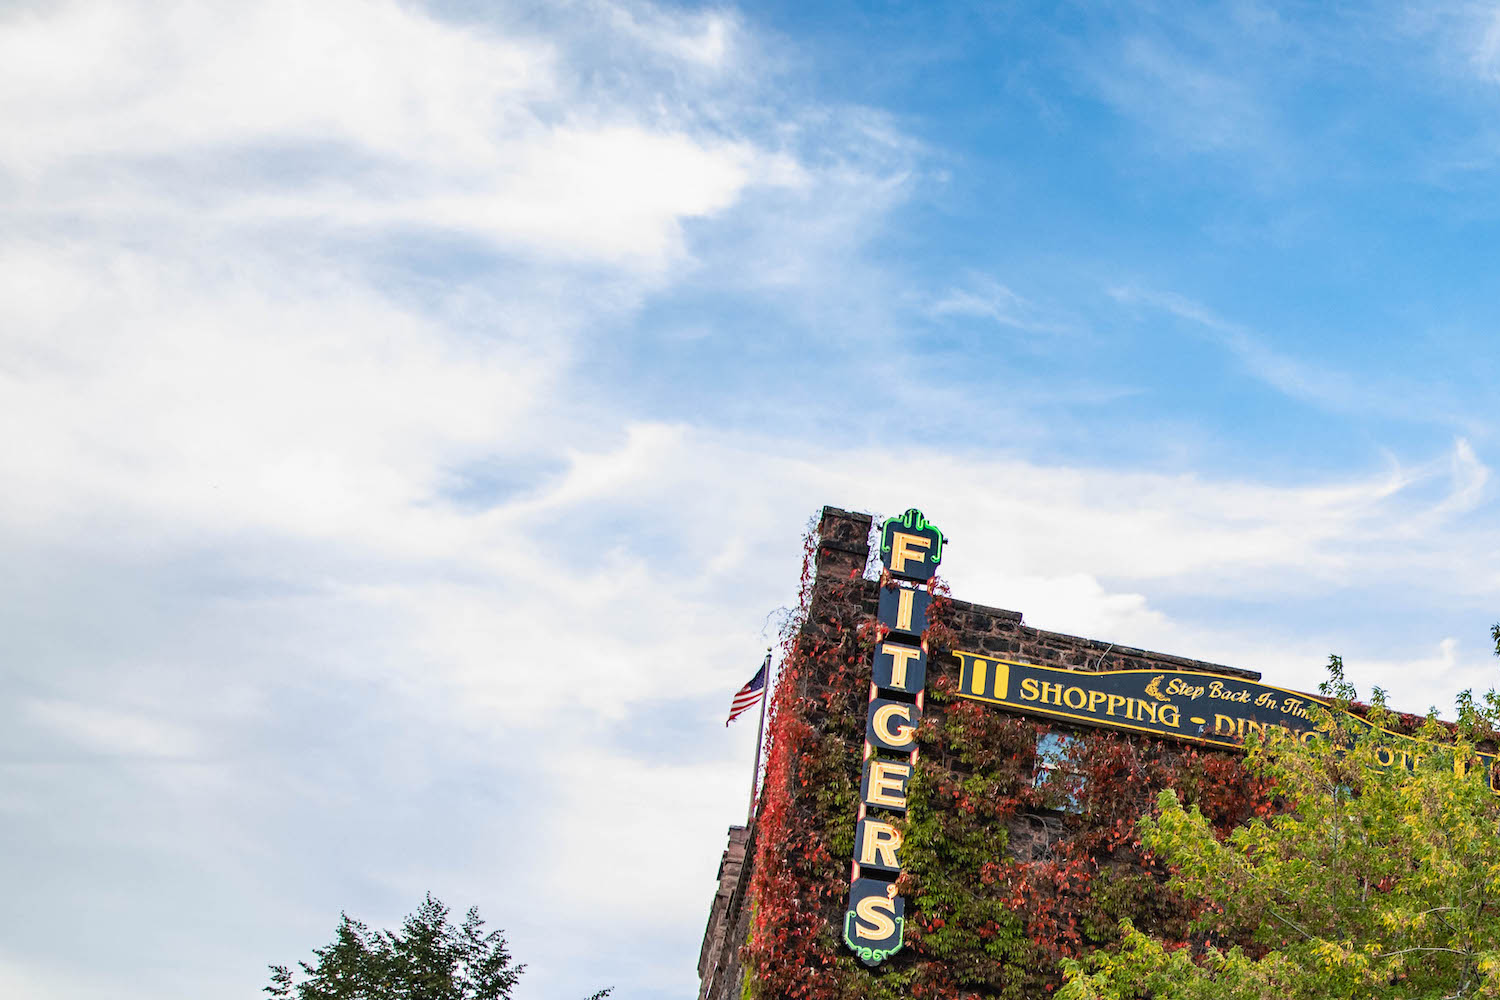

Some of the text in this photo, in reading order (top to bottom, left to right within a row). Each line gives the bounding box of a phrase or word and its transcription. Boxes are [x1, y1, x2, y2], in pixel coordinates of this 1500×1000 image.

[1020, 677, 1181, 728] SHOPPING
[1165, 677, 1314, 721] Step Back In Tim
[854, 531, 932, 941] FITGER'S
